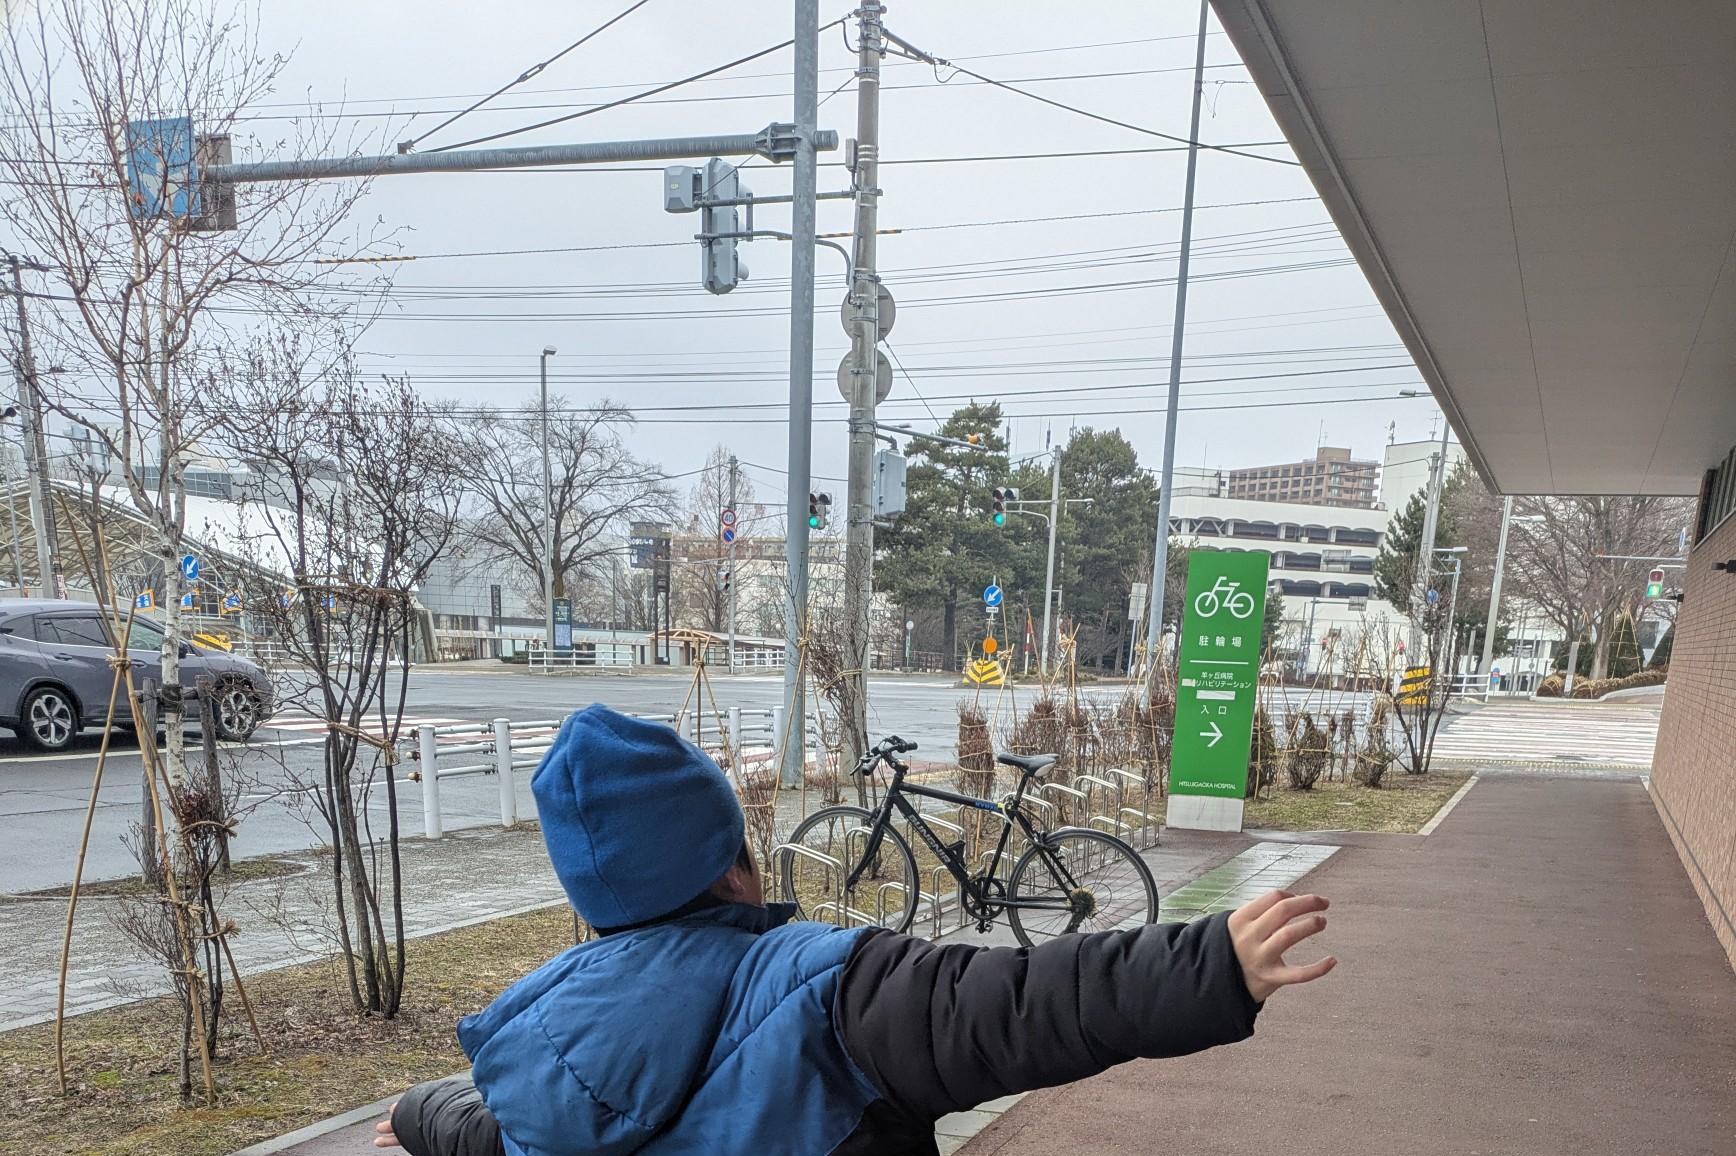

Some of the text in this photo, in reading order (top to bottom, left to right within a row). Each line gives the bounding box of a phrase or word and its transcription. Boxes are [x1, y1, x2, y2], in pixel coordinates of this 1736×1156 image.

[1199, 635, 1242, 648] 駐輪場
[1201, 704, 1227, 715] 入口
